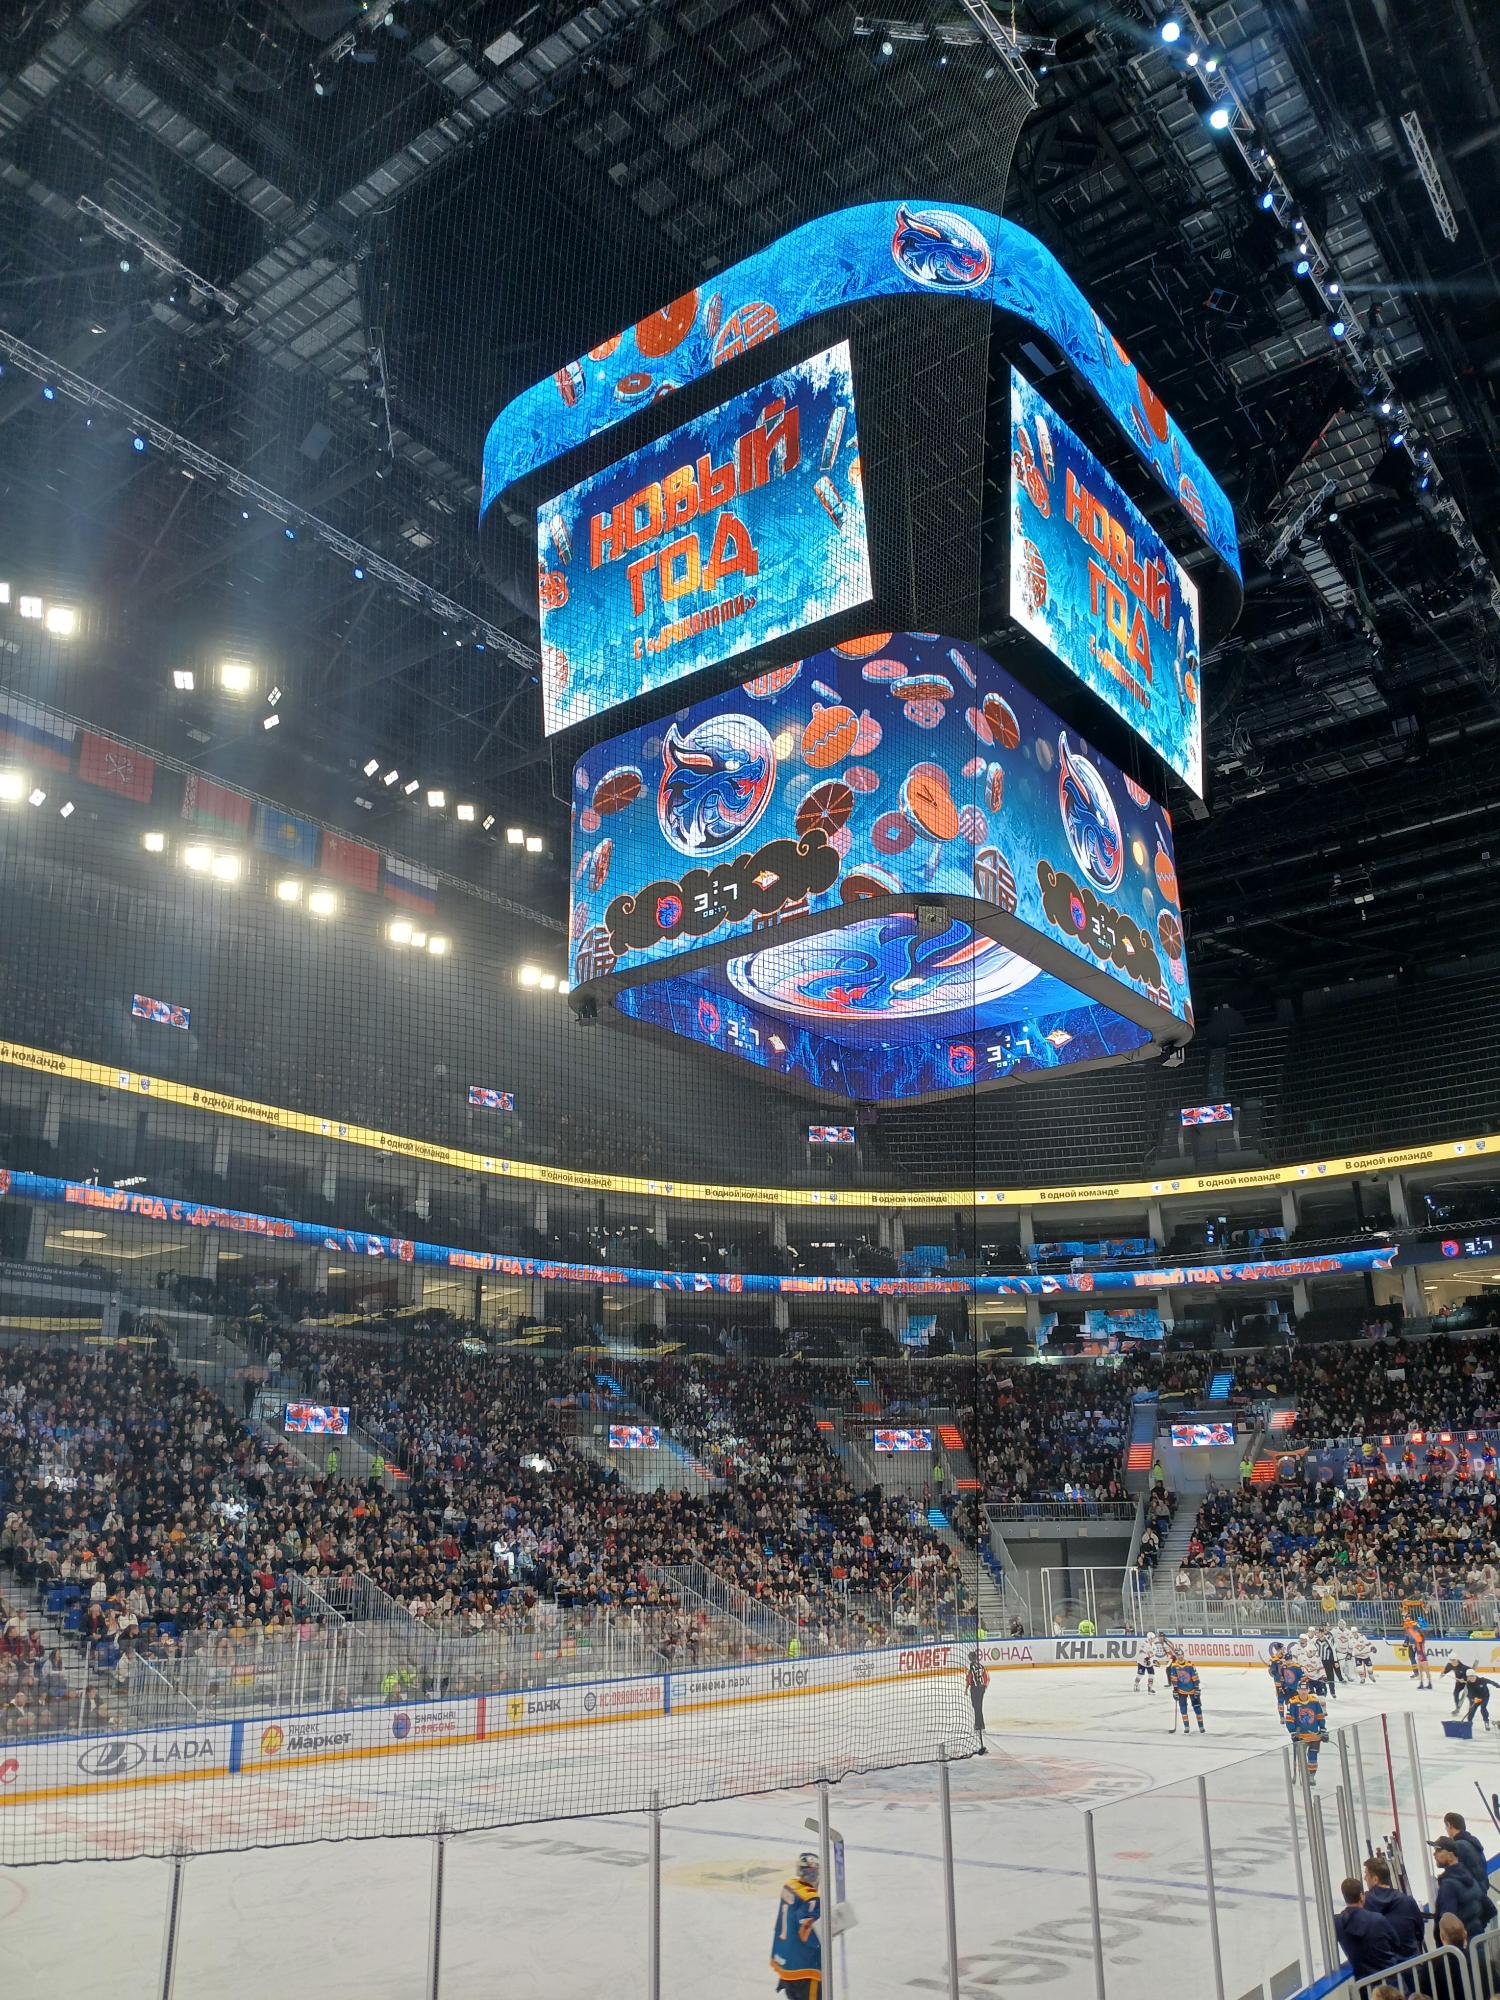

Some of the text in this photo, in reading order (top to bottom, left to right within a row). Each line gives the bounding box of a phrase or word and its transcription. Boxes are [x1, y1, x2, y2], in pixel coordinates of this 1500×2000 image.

[590, 397, 799, 570] НОВЫЙ
[1065, 467, 1171, 630] НОВЫЙ
[627, 512, 759, 617] ГОД
[1088, 557, 1153, 685] ГОД
[11, 1049, 66, 1071] команде
[987, 1039, 1030, 1063] 3:7
[192, 1092, 280, 1121] В одной команде
[380, 1136, 450, 1160] В одной команде
[1345, 1150, 1433, 1169] В одной команде
[541, 1170, 612, 1187] В одной команде
[1198, 1171, 1281, 1188] В одной команде
[65, 1184, 128, 1210] НОВЫЙ
[131, 1196, 167, 1220] ГОД
[705, 1188, 779, 1200] В одной команде
[879, 1195, 906, 1204] одной
[908, 1195, 947, 1203] команде
[1040, 1187, 1120, 1200] В одной команде
[449, 1252, 494, 1271] НОВЫЙ
[495, 1259, 522, 1276] ГОД
[1187, 1268, 1220, 1283] ГОД
[829, 1279, 859, 1294] ГОД
[898, 1647, 950, 1672] FONBET
[1055, 1640, 1137, 1660] KHL.RU
[771, 1665, 809, 1689] Haier
[527, 1700, 561, 1714] БАНК
[414, 1711, 457, 1724] SHANGHAI
[288, 1722, 320, 1735] Яндекс
[414, 1722, 456, 1735] DRAGONS
[152, 1739, 214, 1763] LADA
[286, 1732, 352, 1751] Маркет
